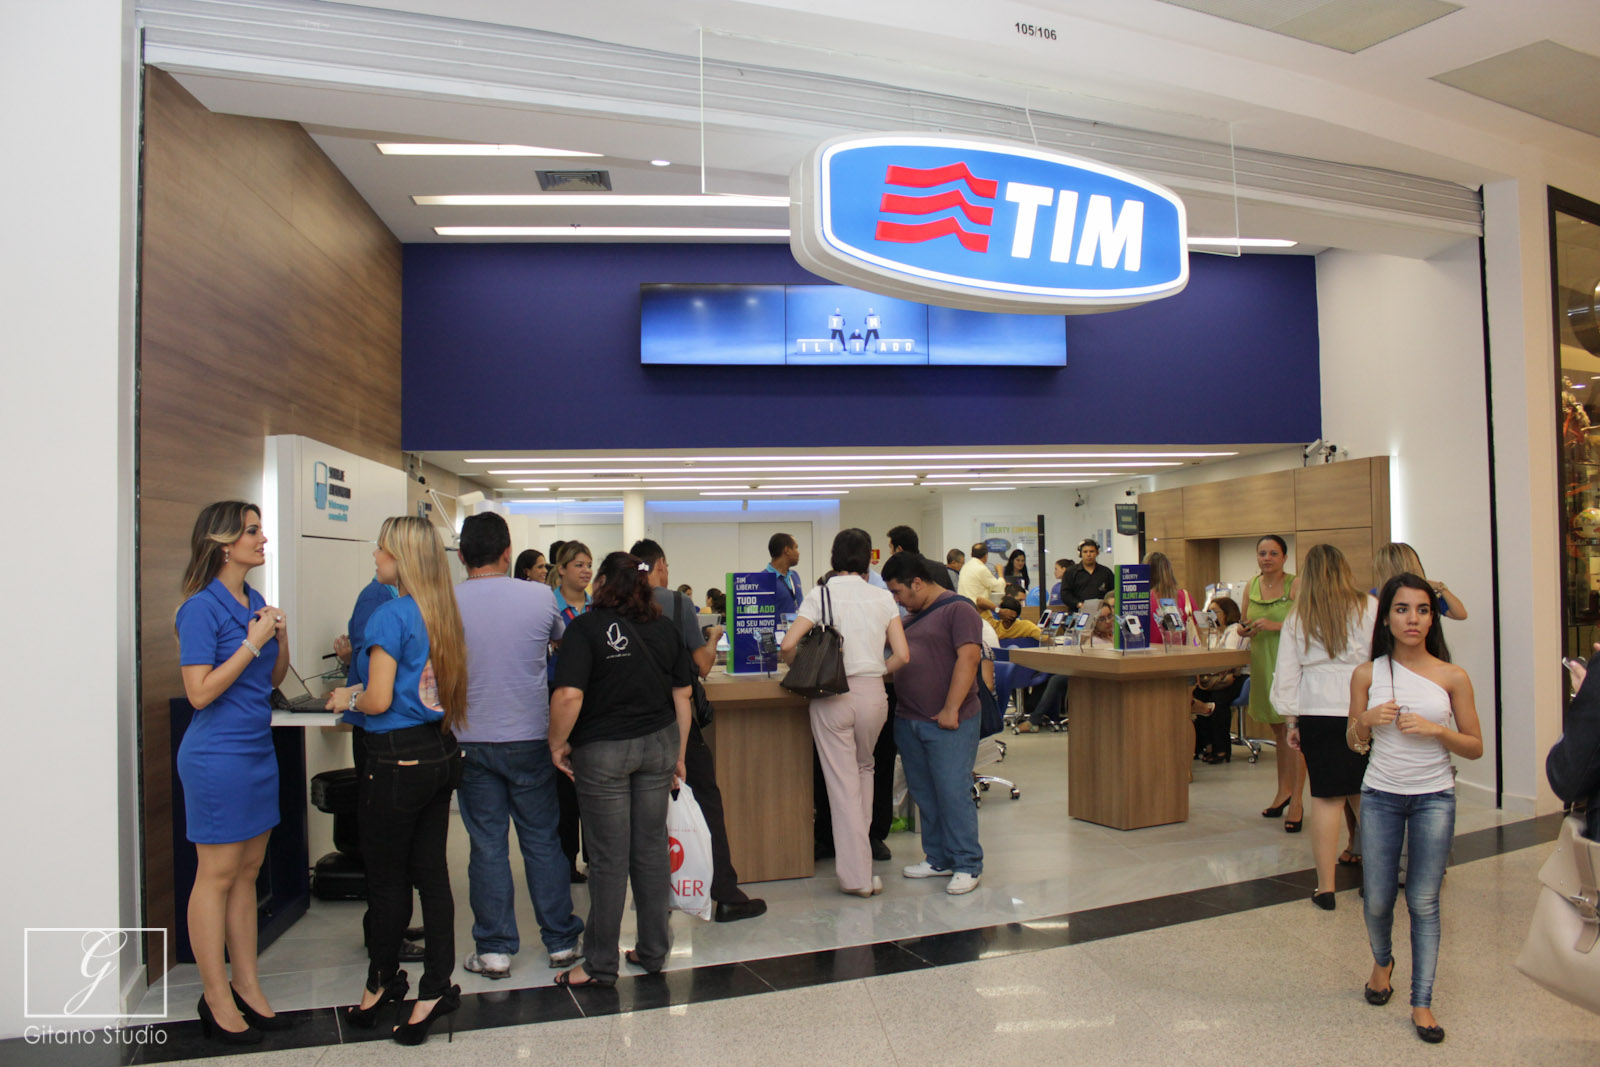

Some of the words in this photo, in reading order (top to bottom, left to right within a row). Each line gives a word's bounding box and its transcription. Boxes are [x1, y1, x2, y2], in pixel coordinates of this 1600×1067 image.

[1015, 22, 1057, 40] 105/106
[1005, 182, 1144, 272] TIM
[737, 596, 757, 605] TUDO
[746, 619, 758, 627] SEU
